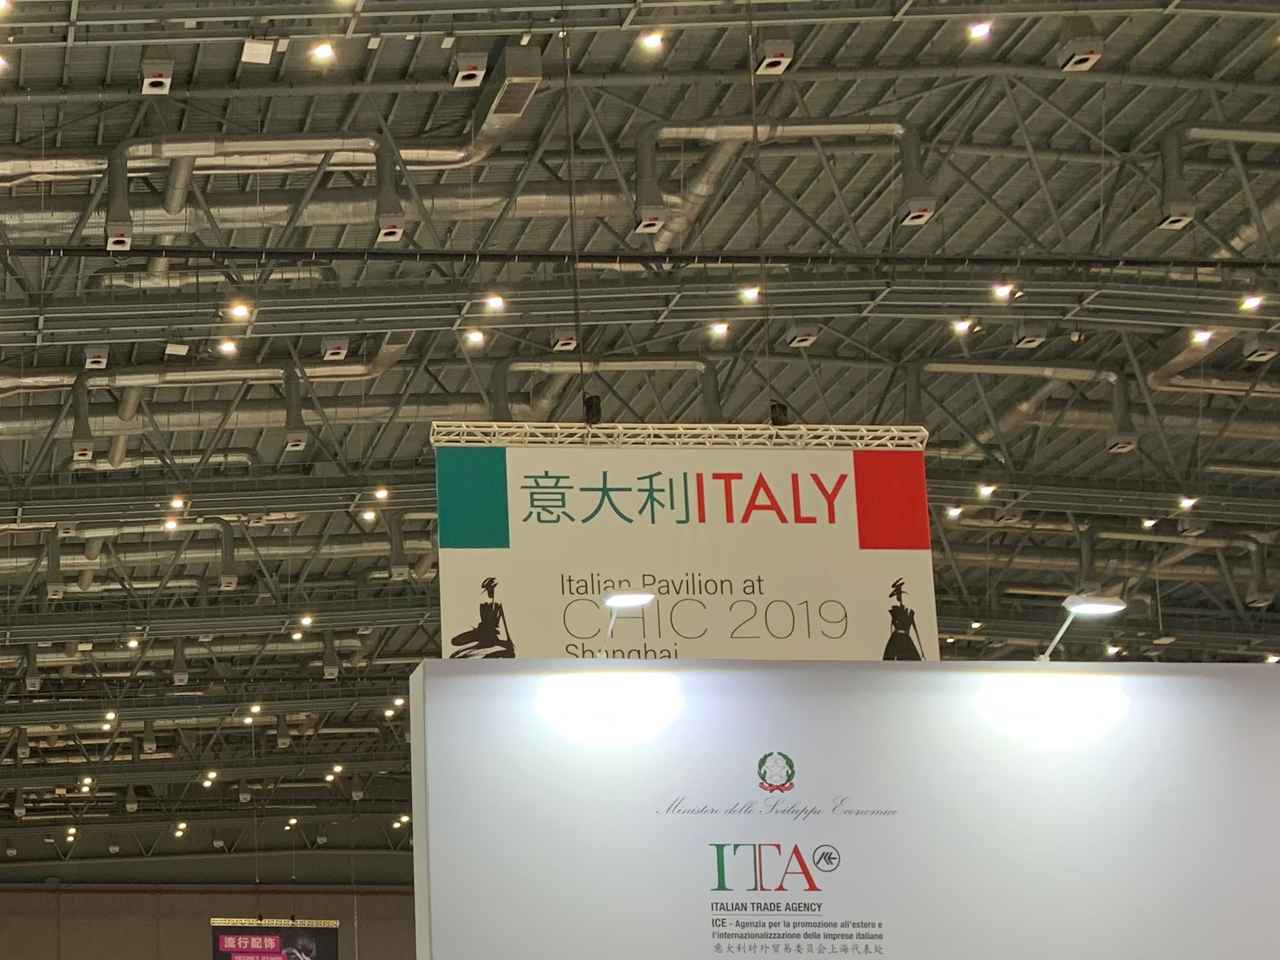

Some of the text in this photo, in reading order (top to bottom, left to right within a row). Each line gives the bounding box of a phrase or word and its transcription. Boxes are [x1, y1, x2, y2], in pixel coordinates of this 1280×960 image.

[641, 573, 733, 596] Pavilion
[742, 575, 765, 596] at
[562, 598, 849, 640] CHIC 2019
[708, 842, 823, 892] ITA
[711, 902, 823, 912] ITALIAN TRADE AGENCY
[711, 918, 727, 928] ICE
[735, 919, 766, 930] Agenzia
[768, 920, 782, 930] per
[783, 919, 791, 929] la
[792, 920, 838, 930] promozione
[803, 931, 821, 940] delle
[823, 931, 854, 941] imprese
